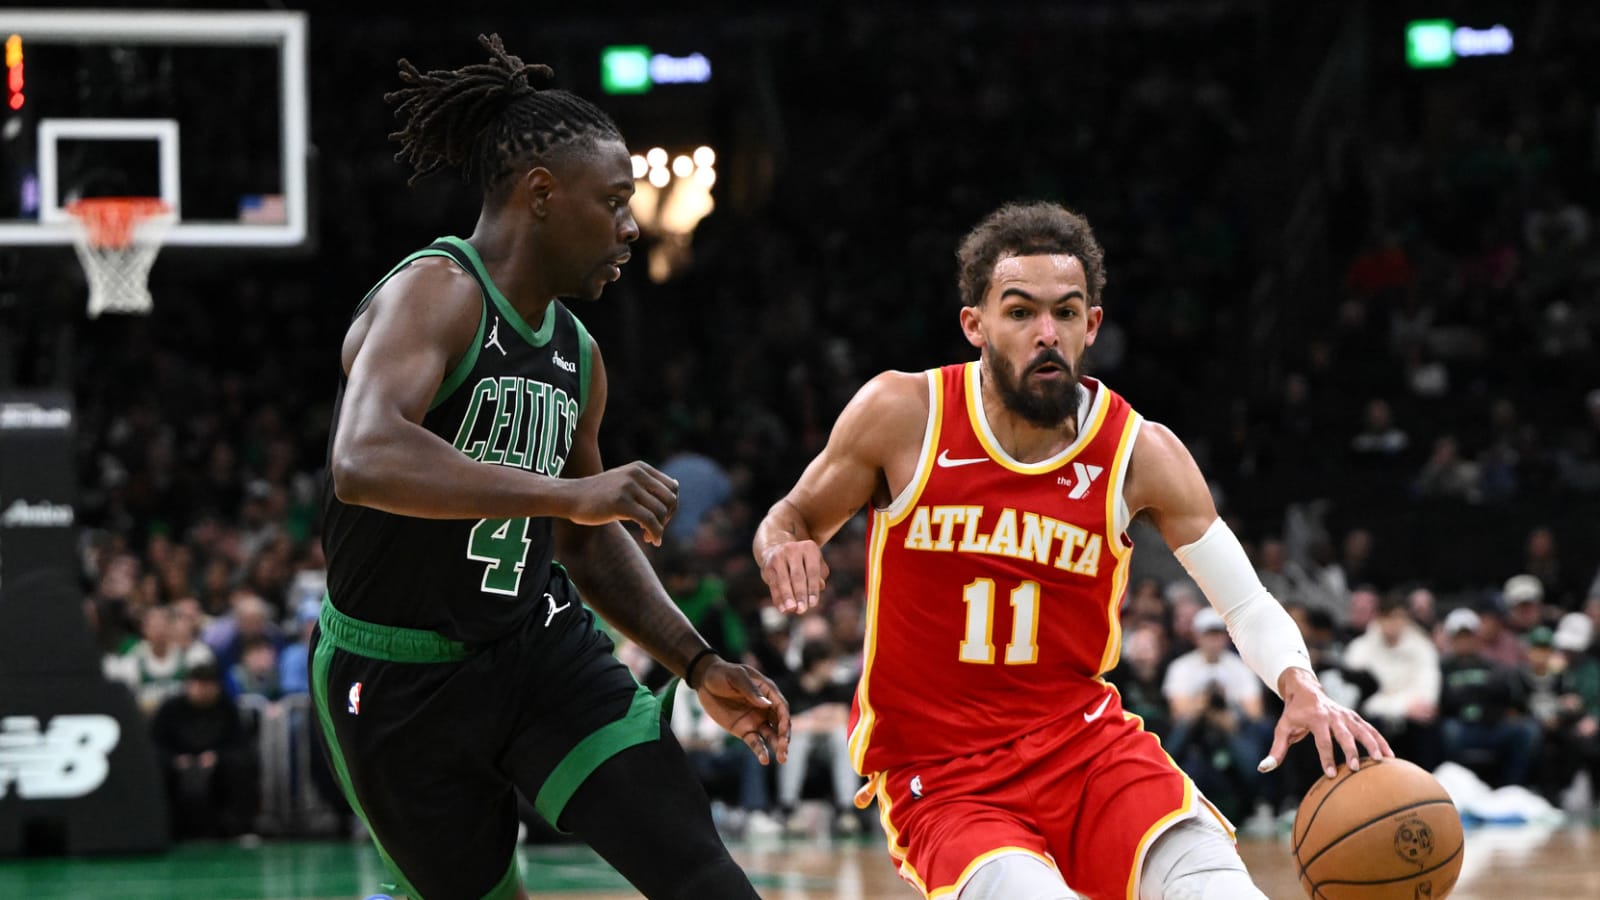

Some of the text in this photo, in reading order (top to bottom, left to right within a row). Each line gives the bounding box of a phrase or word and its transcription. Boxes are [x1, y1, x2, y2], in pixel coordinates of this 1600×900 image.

[1057, 476, 1072, 487] the
[467, 516, 532, 597] 4
[904, 505, 1103, 577] ATLANTA
[958, 577, 1041, 665] 11
